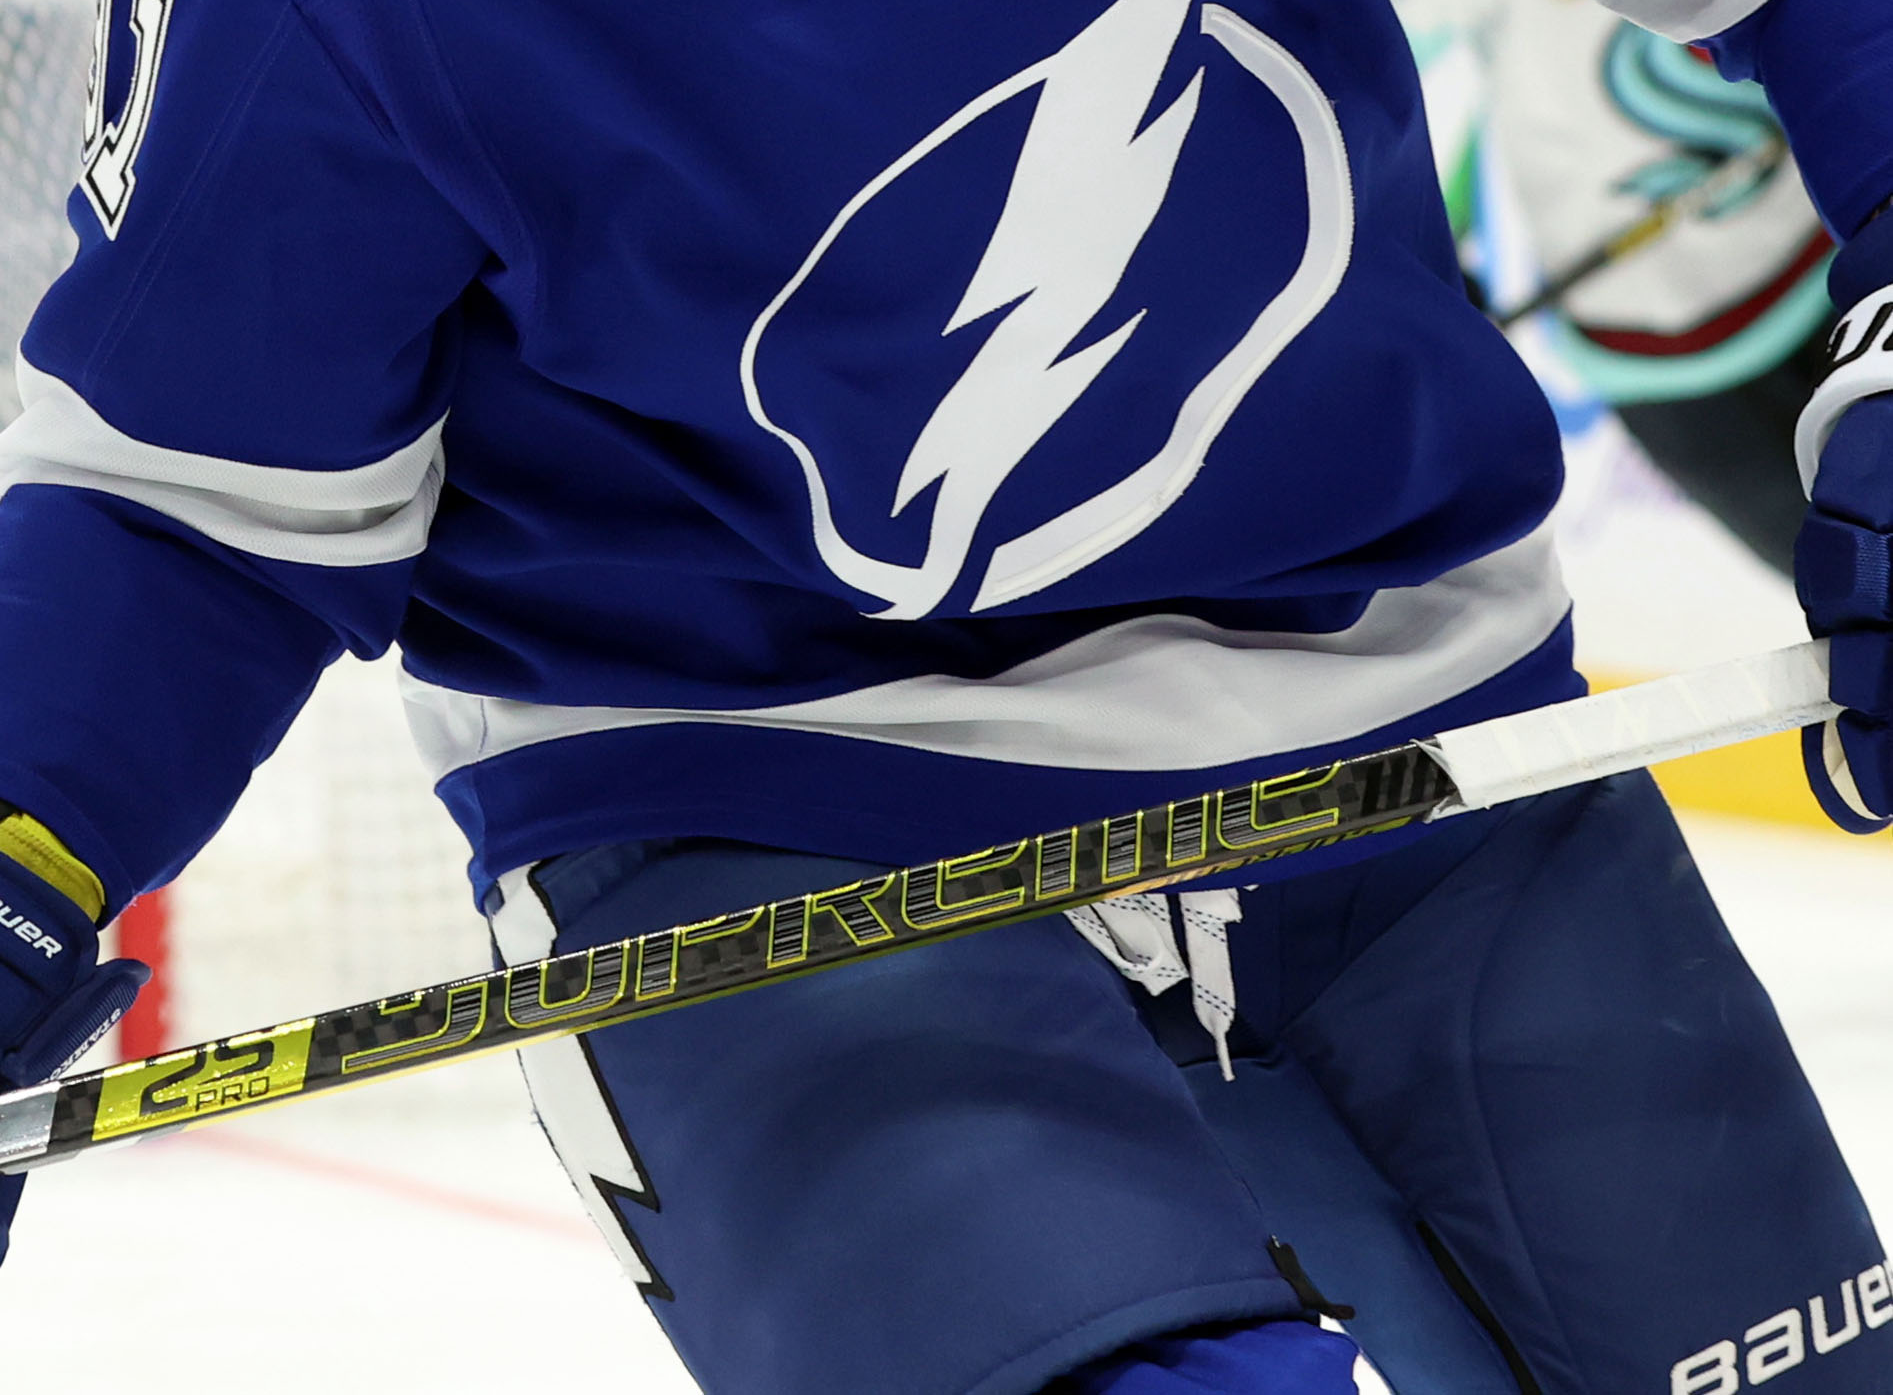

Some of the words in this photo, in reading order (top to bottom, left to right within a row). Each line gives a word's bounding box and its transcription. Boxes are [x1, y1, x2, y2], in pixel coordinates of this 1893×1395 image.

[0, 900, 64, 959] UER
[195, 1076, 270, 1112] PRO
[1670, 1259, 1893, 1395] BAUE
